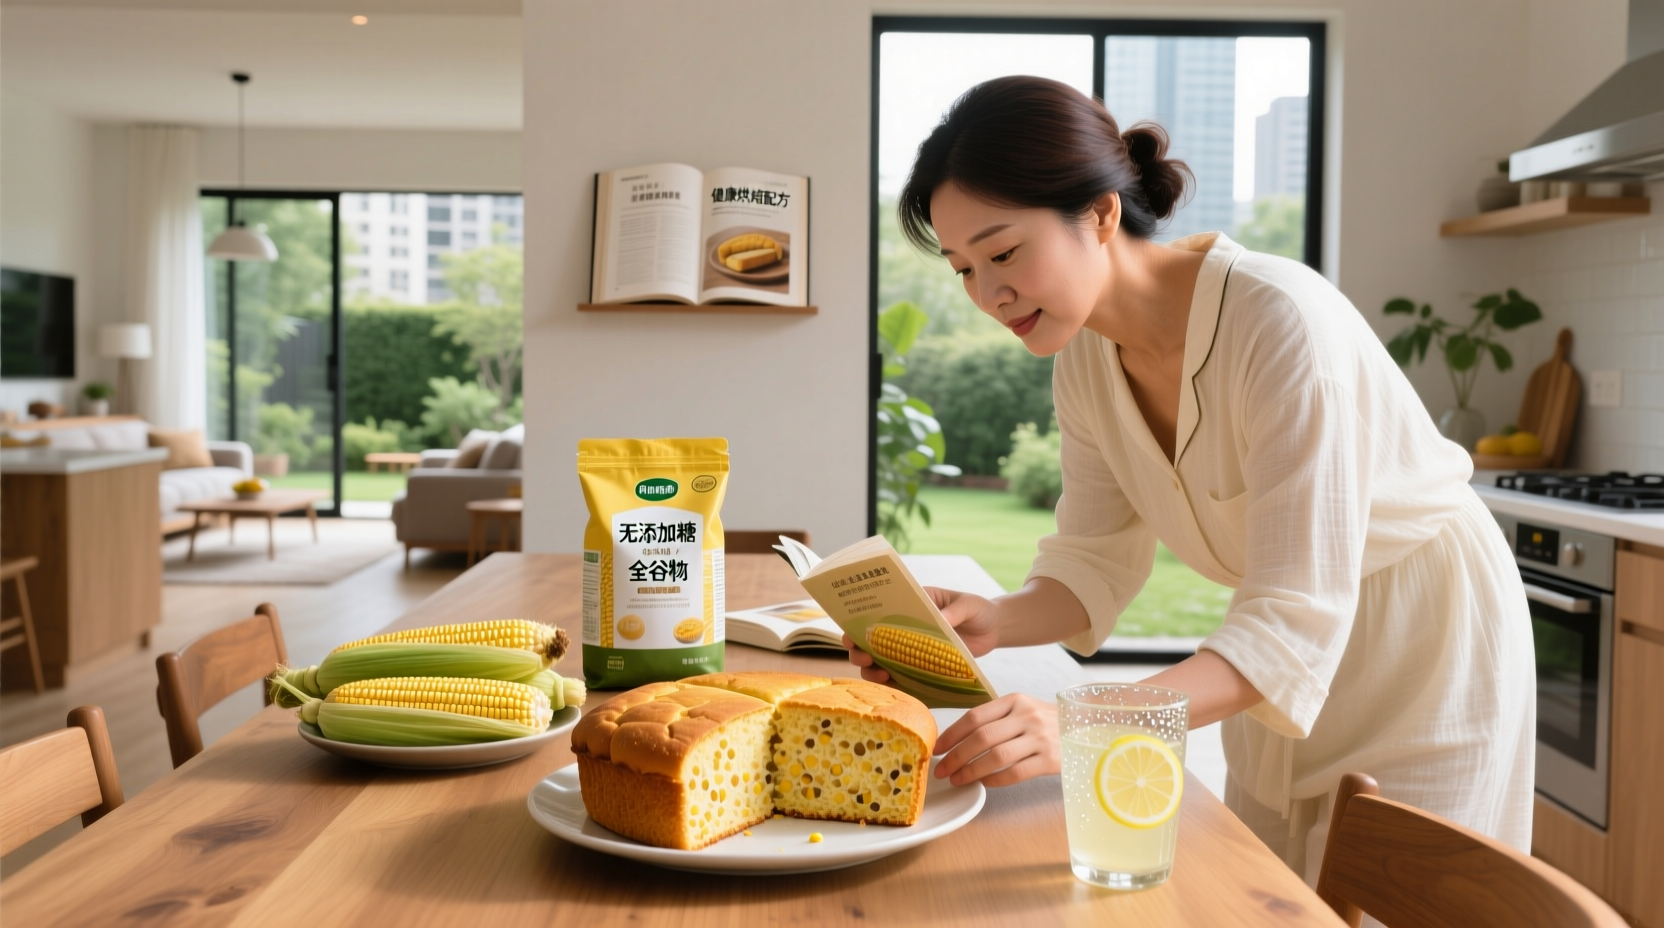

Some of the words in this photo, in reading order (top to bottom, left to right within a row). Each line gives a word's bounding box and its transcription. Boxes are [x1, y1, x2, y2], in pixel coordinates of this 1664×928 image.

[711, 187, 790, 208] 健康烘焙配方
[619, 521, 696, 543] 无添加糖
[628, 559, 688, 582] 全谷物
